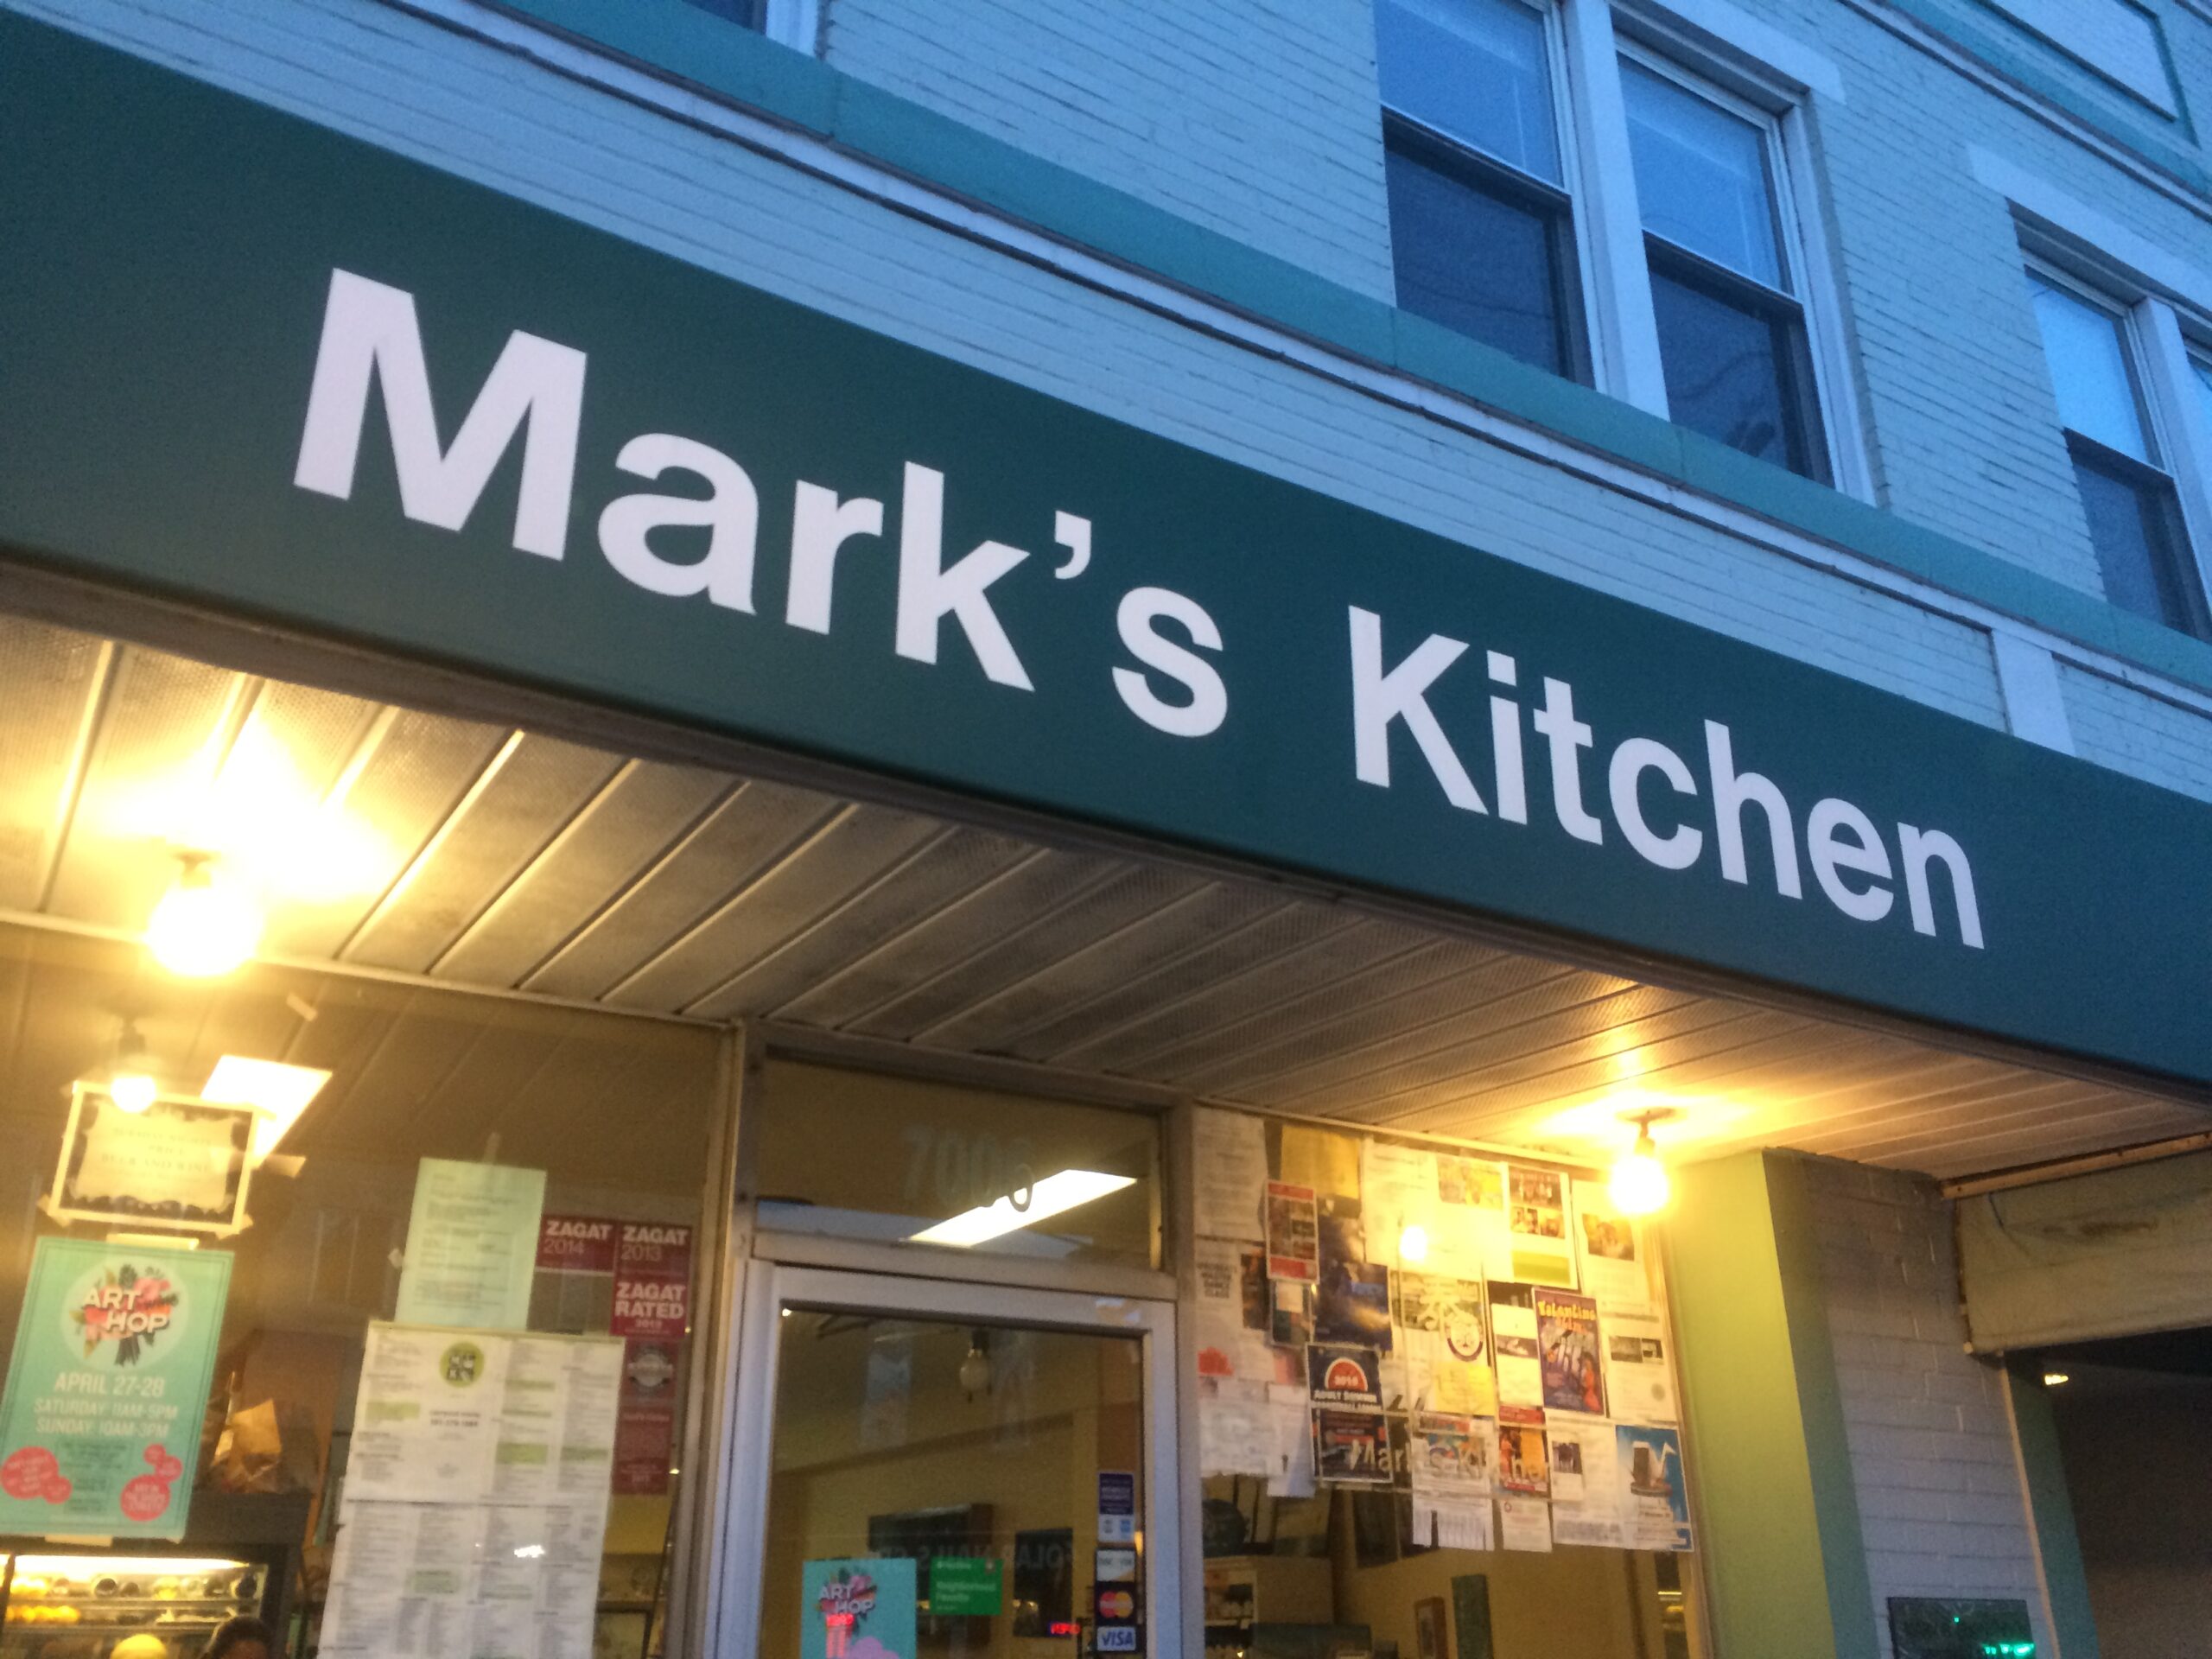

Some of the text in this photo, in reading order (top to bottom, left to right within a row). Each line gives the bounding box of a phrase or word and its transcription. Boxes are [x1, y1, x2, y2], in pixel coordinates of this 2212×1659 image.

[294, 267, 1985, 950] Mark’s Kitchen
[546, 1219, 613, 1241] ZAGAT
[621, 1224, 689, 1245] ZAGAT
[543, 1238, 586, 1255] 2014
[82, 1287, 143, 1312] ART
[616, 1281, 687, 1302] ZAGAT
[614, 1300, 685, 1320] RATED
[105, 1312, 170, 1335] HOP
[54, 1371, 166, 1398] APRIL 27-28
[34, 1396, 105, 1417] SATURDAY
[35, 1416, 92, 1435] SUNDAY
[817, 1582, 855, 1600] ART
[833, 1599, 875, 1615] HOP
[1101, 1629, 1135, 1648] VISA
